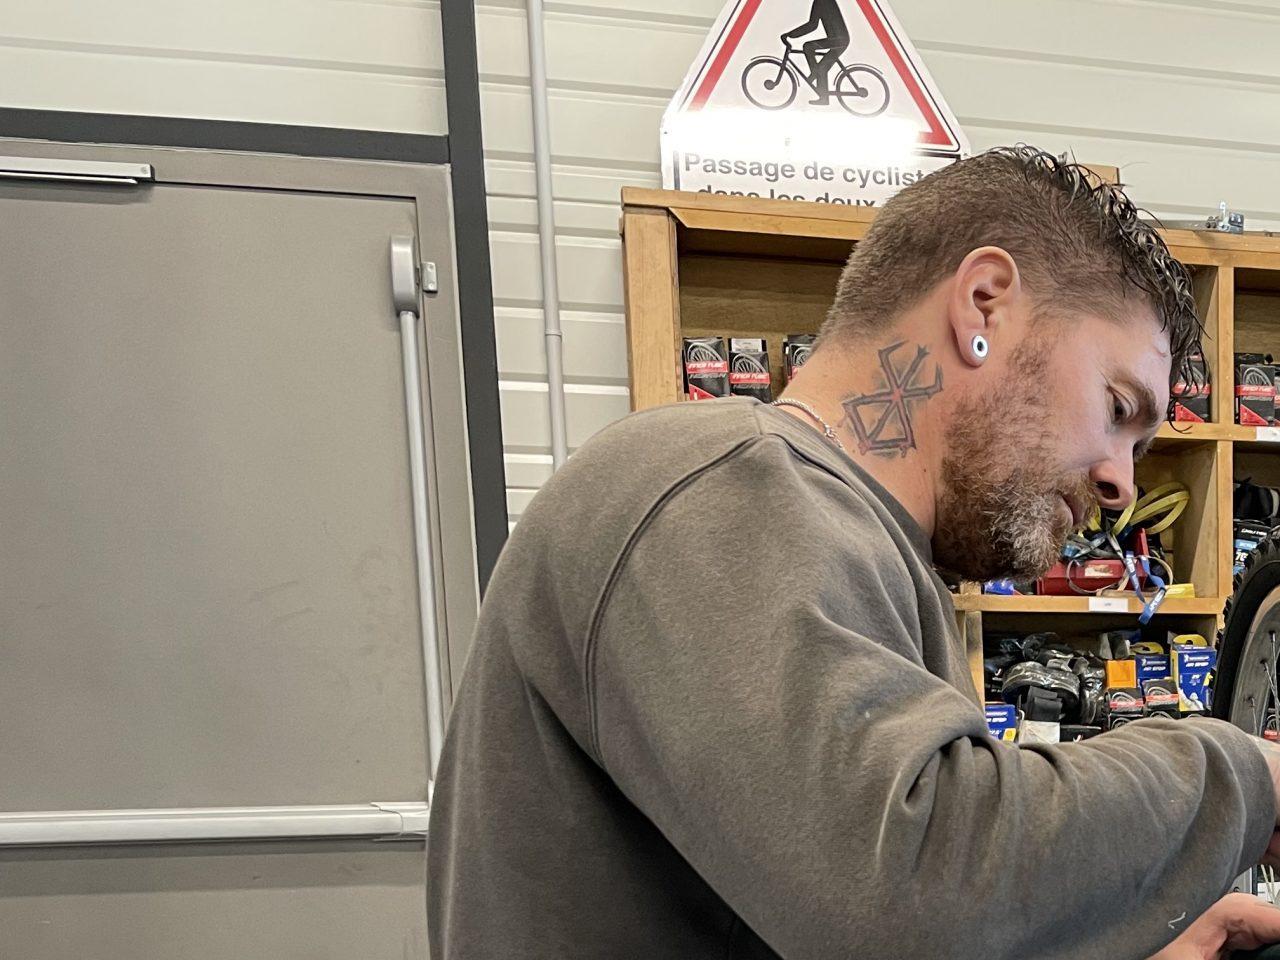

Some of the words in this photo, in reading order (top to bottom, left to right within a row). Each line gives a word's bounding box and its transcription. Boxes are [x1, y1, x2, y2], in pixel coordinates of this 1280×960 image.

[685, 152, 796, 182] Passage
[803, 161, 834, 181] de
[843, 165, 923, 188] cyclist
